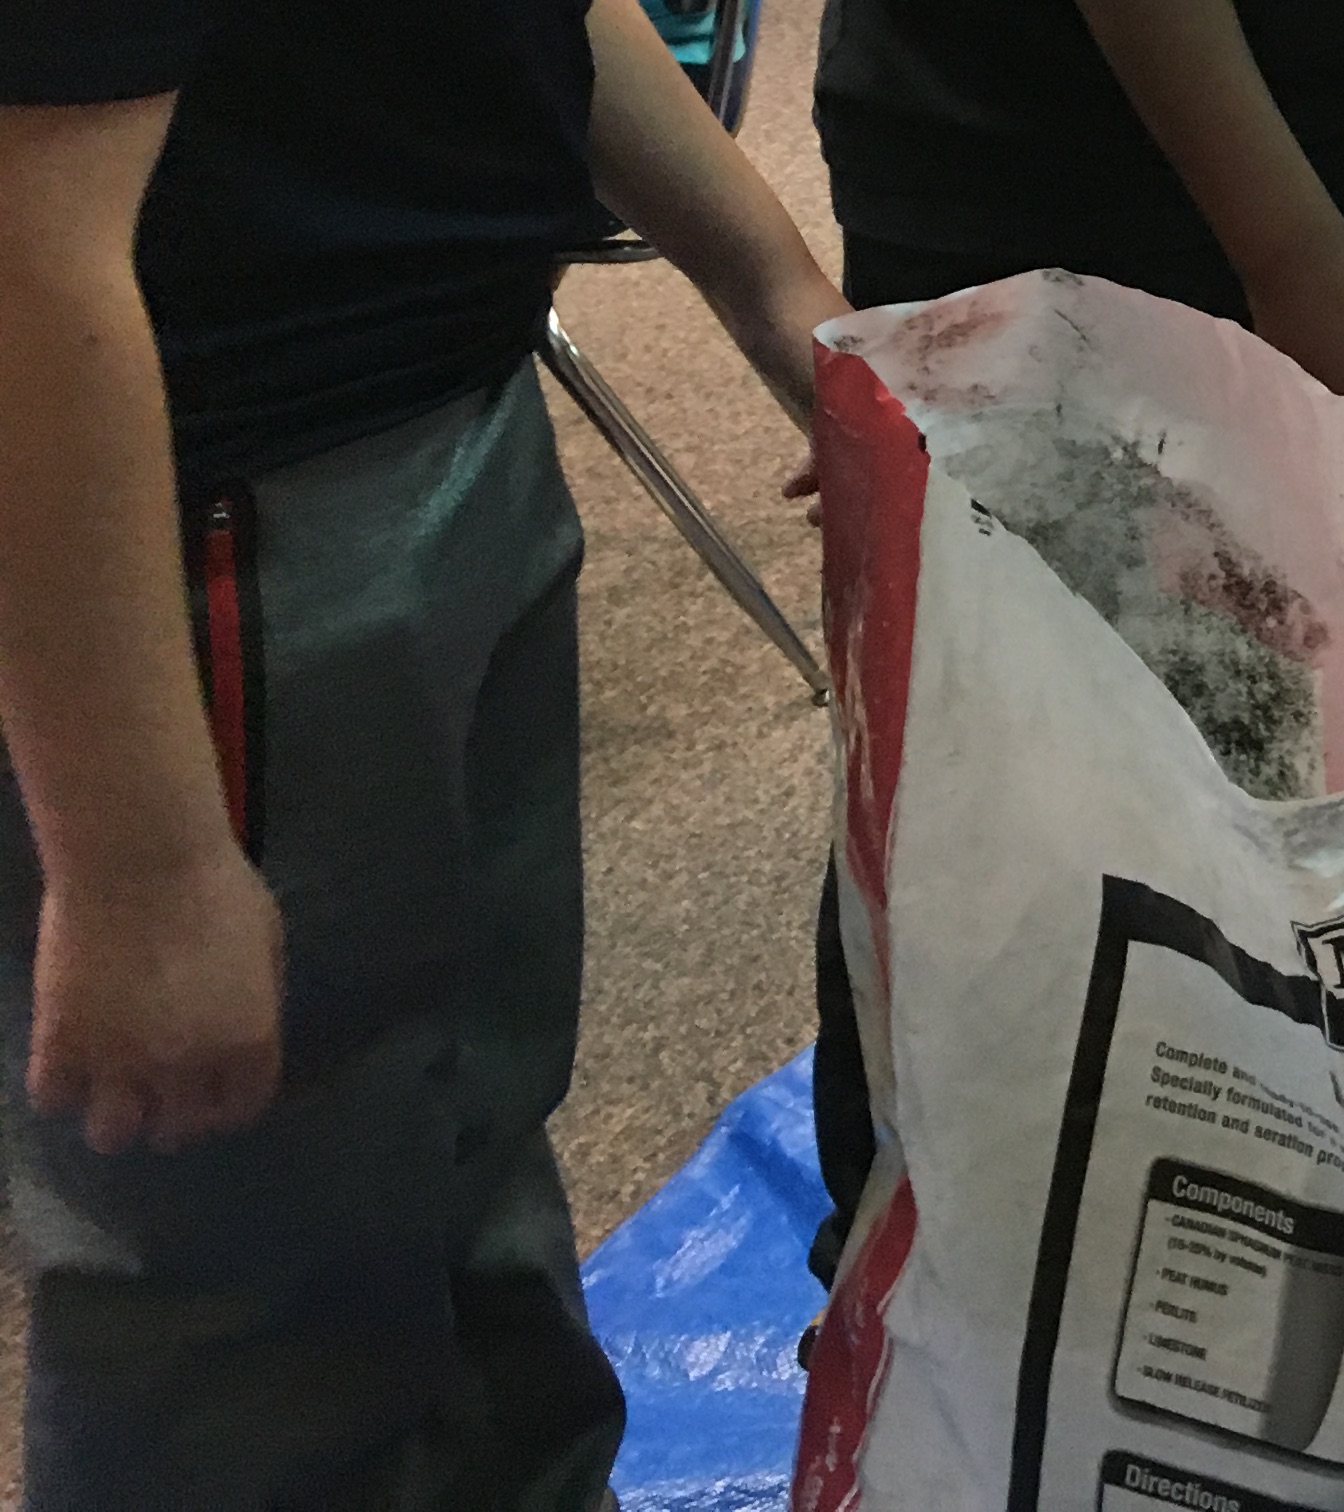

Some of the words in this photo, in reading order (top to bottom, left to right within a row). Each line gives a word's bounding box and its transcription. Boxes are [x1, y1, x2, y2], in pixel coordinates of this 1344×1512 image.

[1155, 1040, 1228, 1075] Complete
[1145, 1093, 1216, 1125] retention
[1221, 1112, 1250, 1135] and
[1254, 1123, 1314, 1158] aeration
[1150, 1065, 1222, 1101] Specially
[1226, 1086, 1304, 1129] formulated
[1171, 1174, 1296, 1236] Components
[1125, 1462, 1242, 1512] Directions
